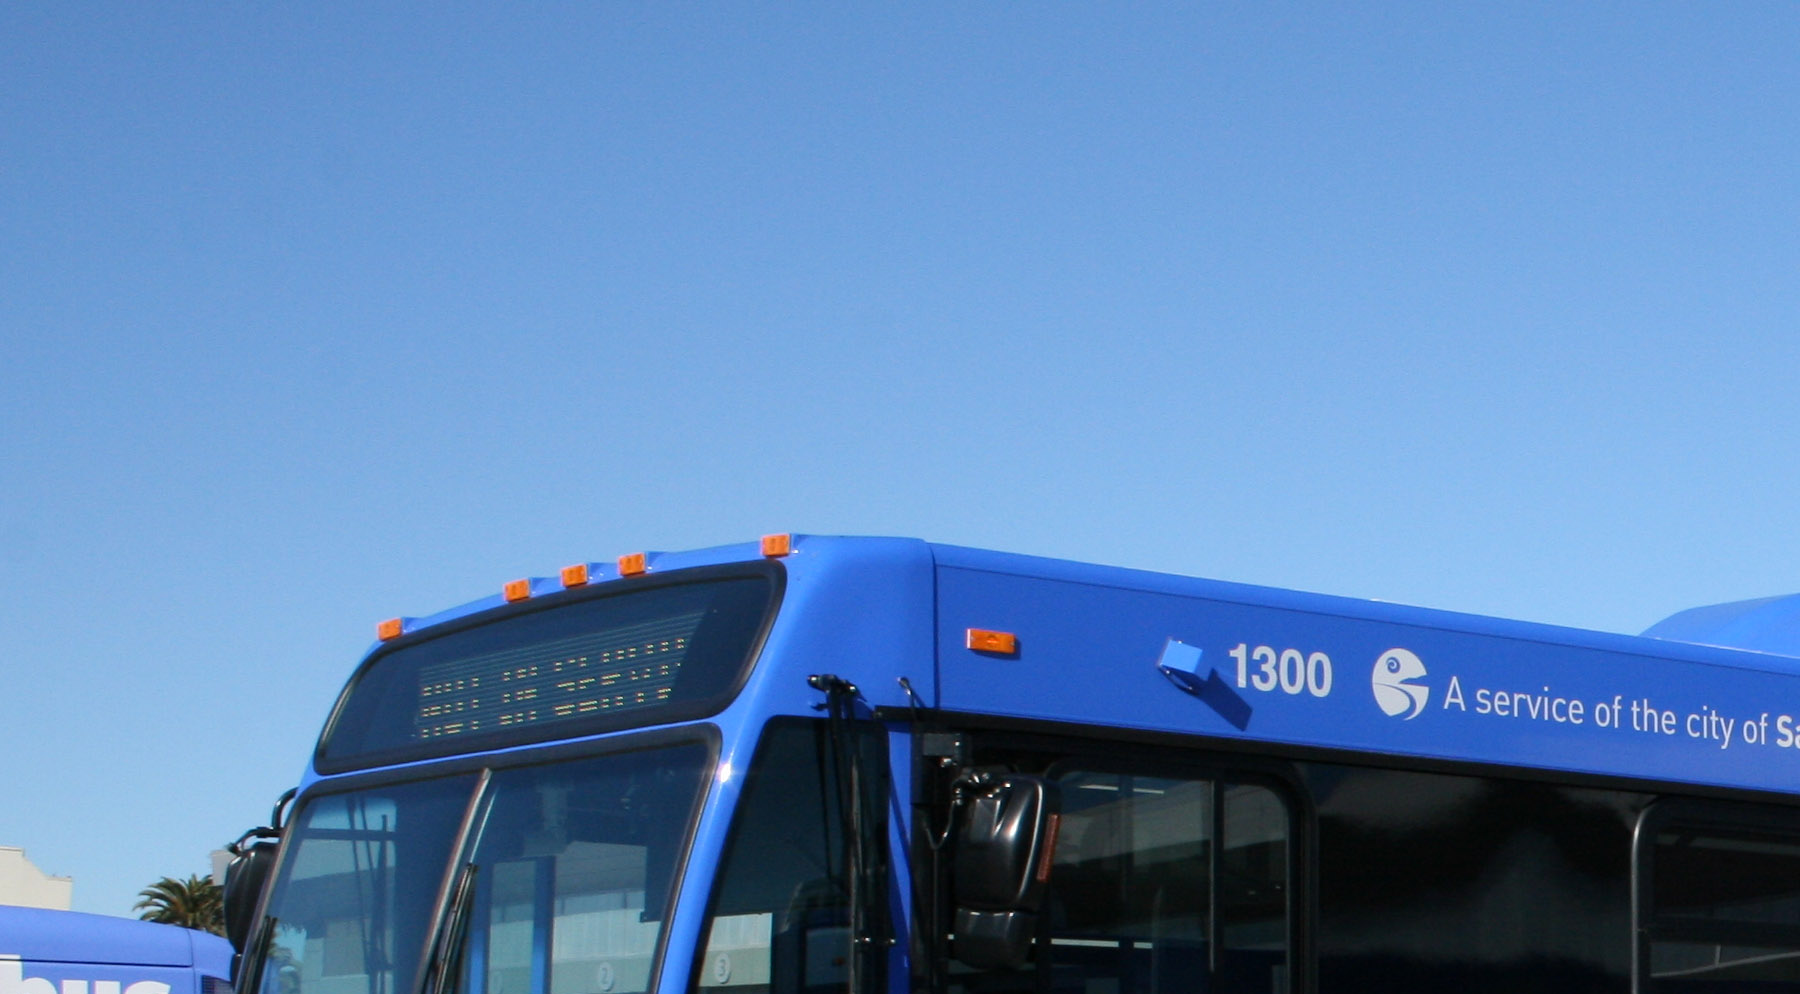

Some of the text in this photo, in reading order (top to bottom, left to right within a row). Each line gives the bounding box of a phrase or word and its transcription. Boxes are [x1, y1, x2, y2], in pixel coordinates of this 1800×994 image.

[1229, 643, 1333, 698] 1300
[1443, 676, 1466, 711] A
[1475, 687, 1585, 724] service
[1594, 696, 1622, 728] of
[1631, 698, 1676, 735] the
[1686, 705, 1735, 749] city
[1743, 713, 1768, 745] of
